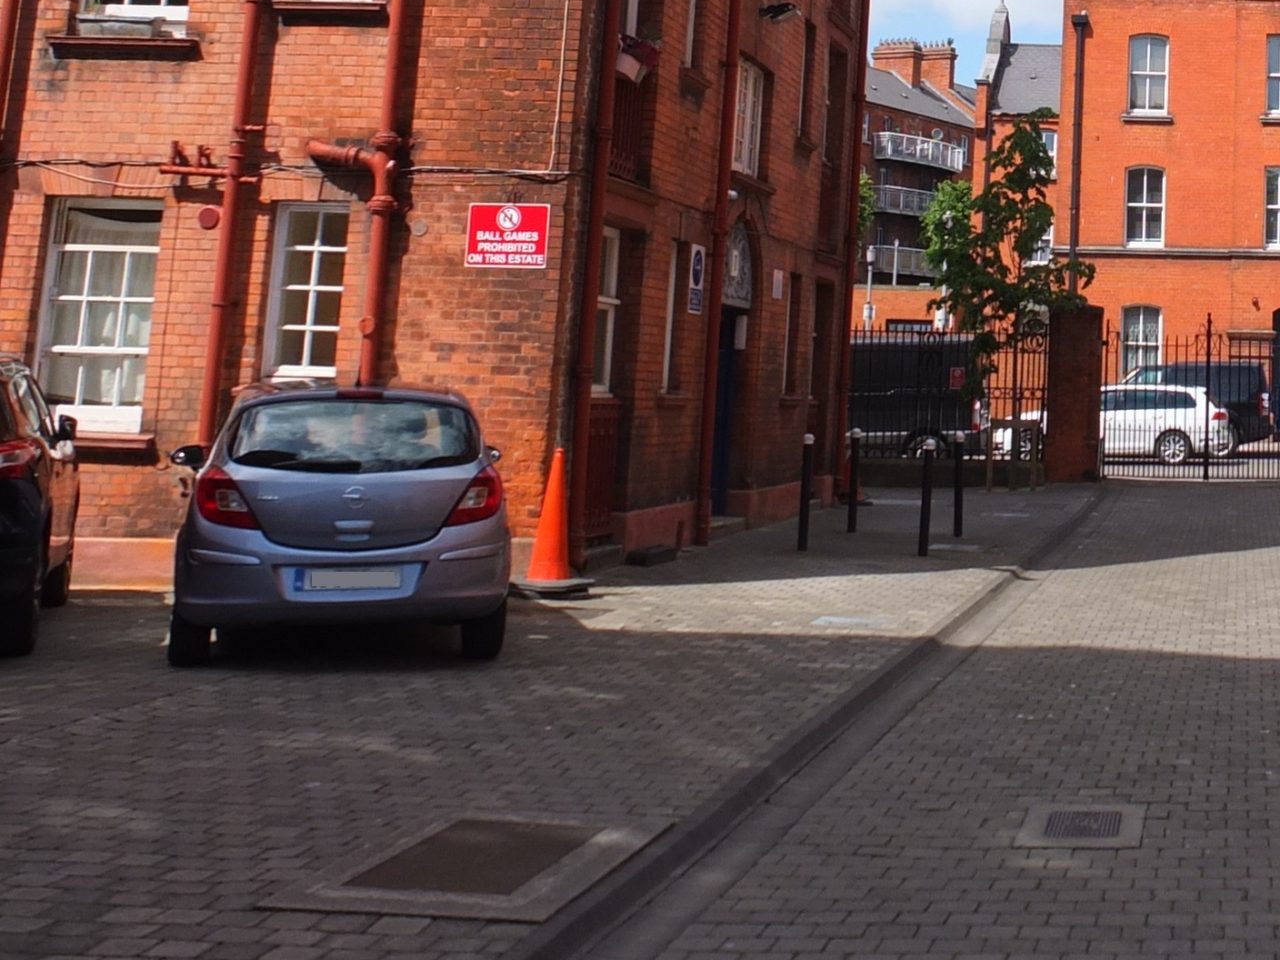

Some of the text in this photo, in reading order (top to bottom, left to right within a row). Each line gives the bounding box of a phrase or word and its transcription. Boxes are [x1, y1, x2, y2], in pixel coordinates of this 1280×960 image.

[476, 230, 539, 242] BALL GAMES
[477, 242, 536, 253] PROHIBITED
[468, 253, 545, 265] ON THIS ESTATE
